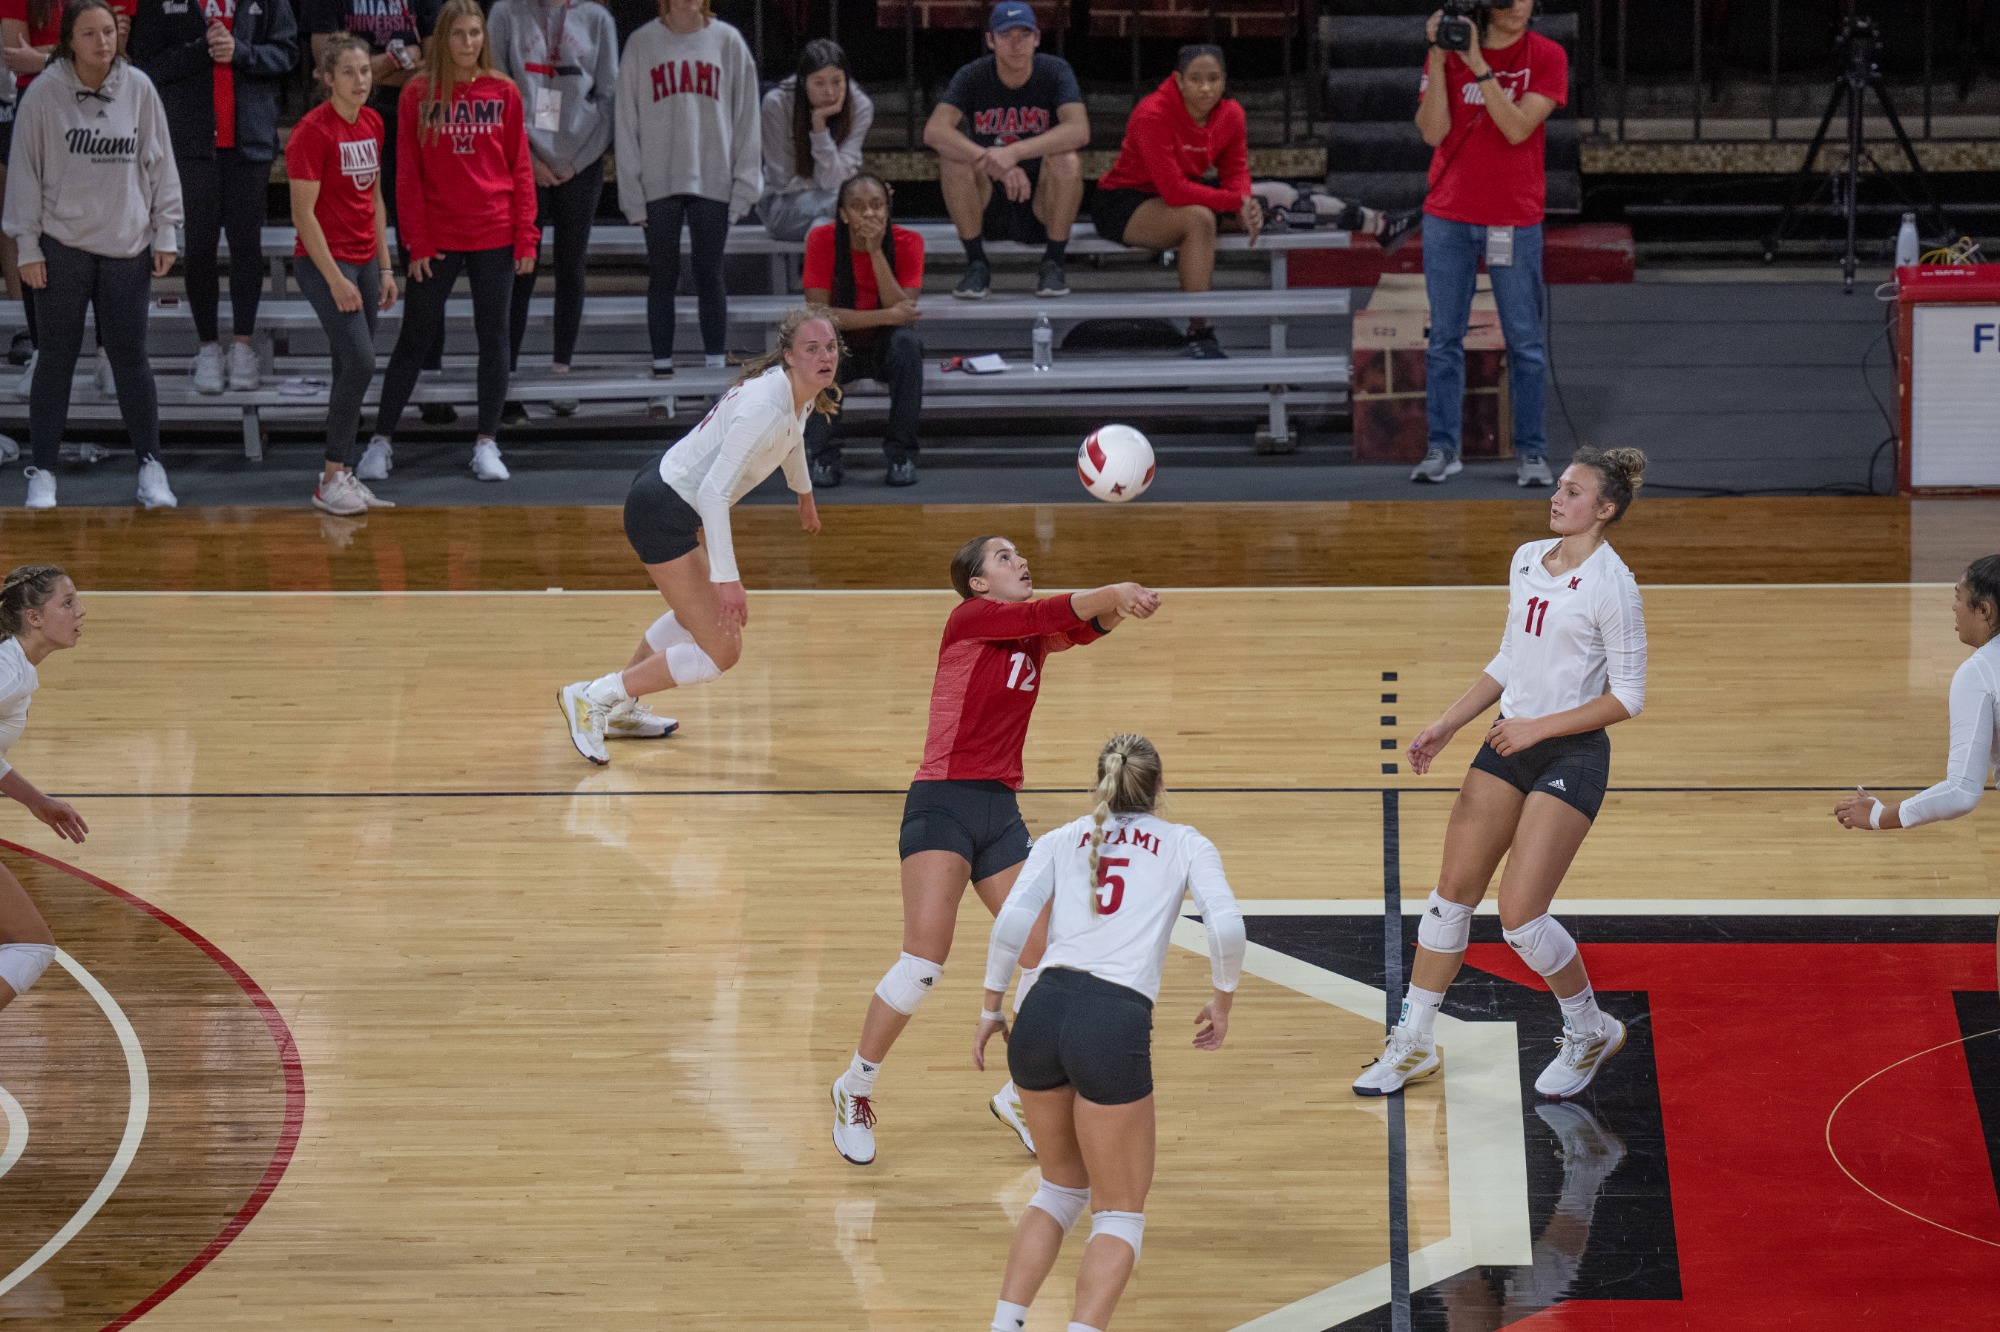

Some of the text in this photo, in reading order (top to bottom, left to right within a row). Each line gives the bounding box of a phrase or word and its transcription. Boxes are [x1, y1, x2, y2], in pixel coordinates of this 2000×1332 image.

[649, 60, 721, 103] MIAMI
[974, 106, 1050, 135] MIAMI
[65, 127, 137, 155] Miami
[341, 141, 378, 168] MIAMI
[1974, 323, 2000, 353] F
[1525, 596, 1549, 637] 11
[1006, 651, 1037, 692] 12
[1095, 855, 1131, 915] 5
